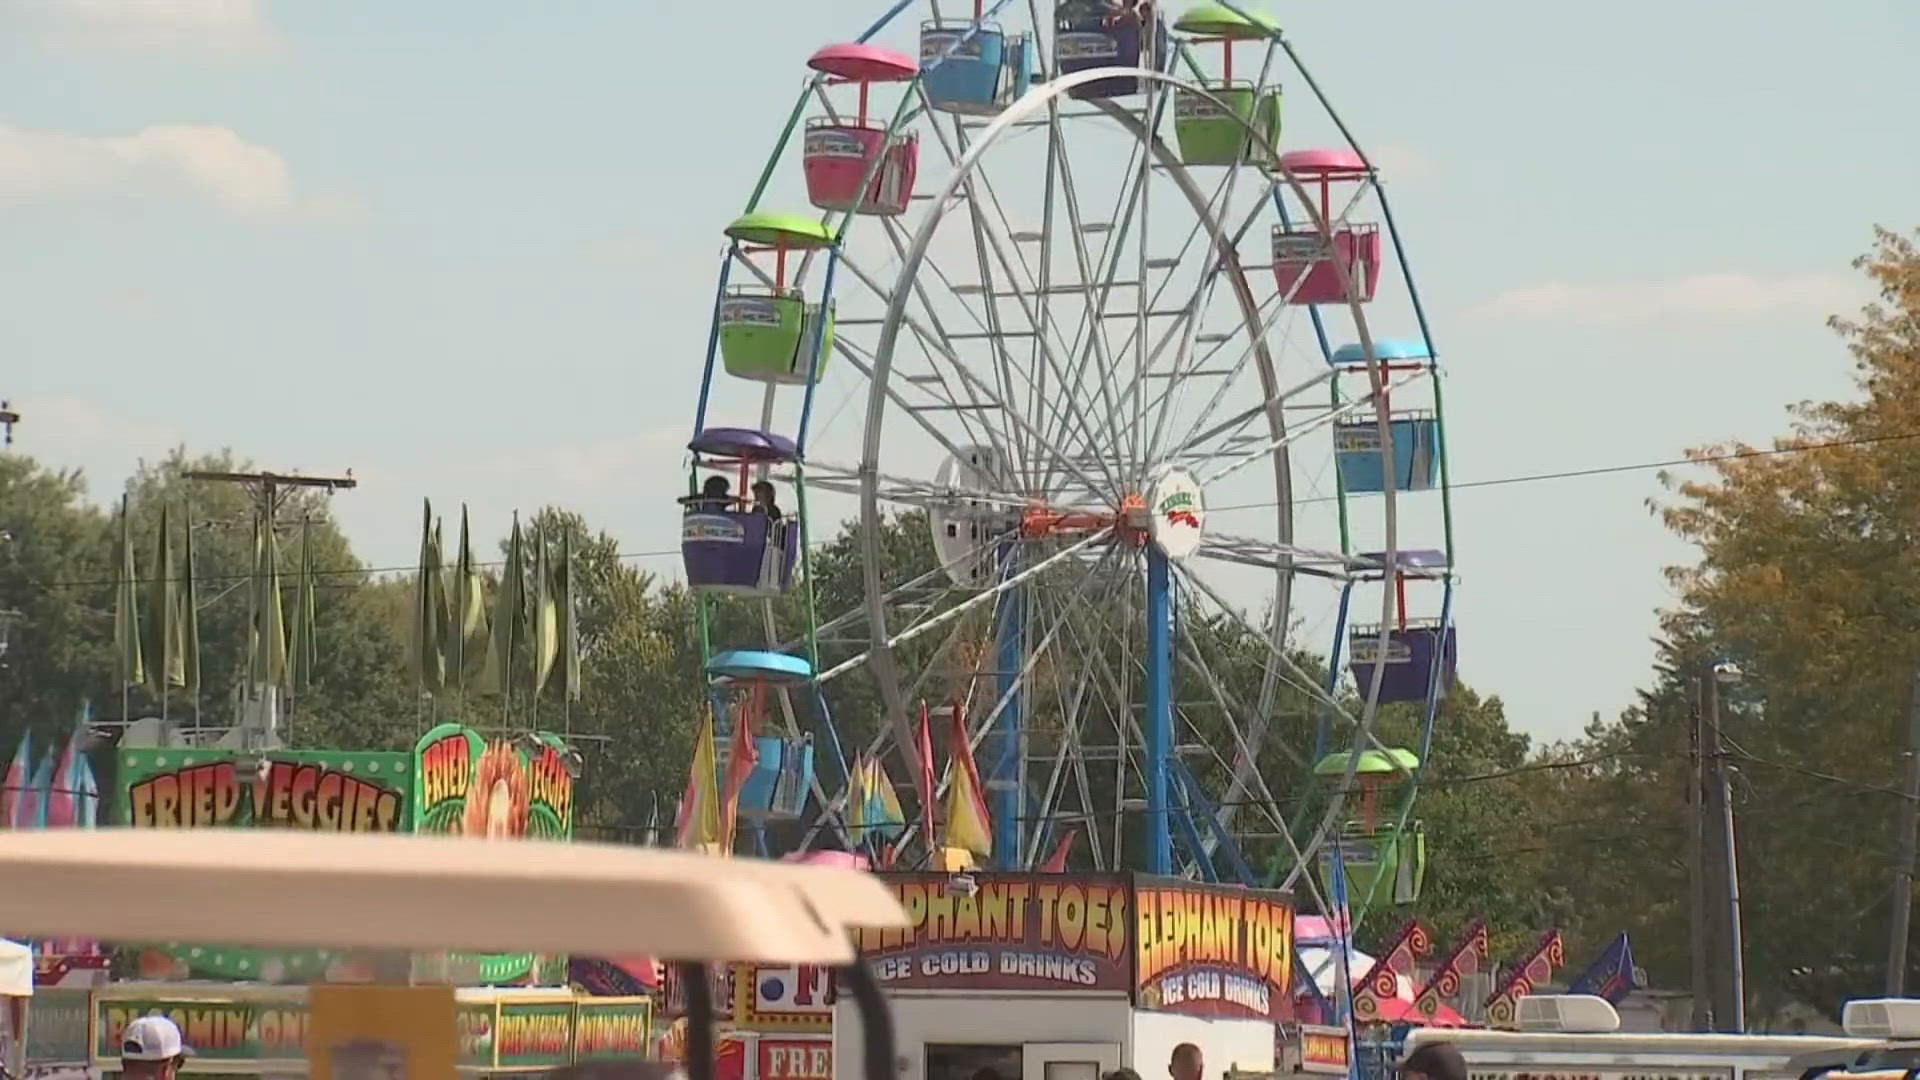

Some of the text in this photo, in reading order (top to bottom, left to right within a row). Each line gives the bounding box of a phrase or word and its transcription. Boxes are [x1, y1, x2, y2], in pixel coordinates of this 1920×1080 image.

[131, 761, 397, 831] FRIED VEGGIES
[423, 736, 469, 812] FRIED
[1038, 884, 1127, 962] TOES
[1137, 890, 1292, 998] ELEPHANT TOES
[921, 951, 990, 978] COLD
[1000, 952, 1097, 986] DRINKS
[1161, 972, 1270, 1016] ICE COLD DRINKS
[768, 1046, 832, 1078] FRE
